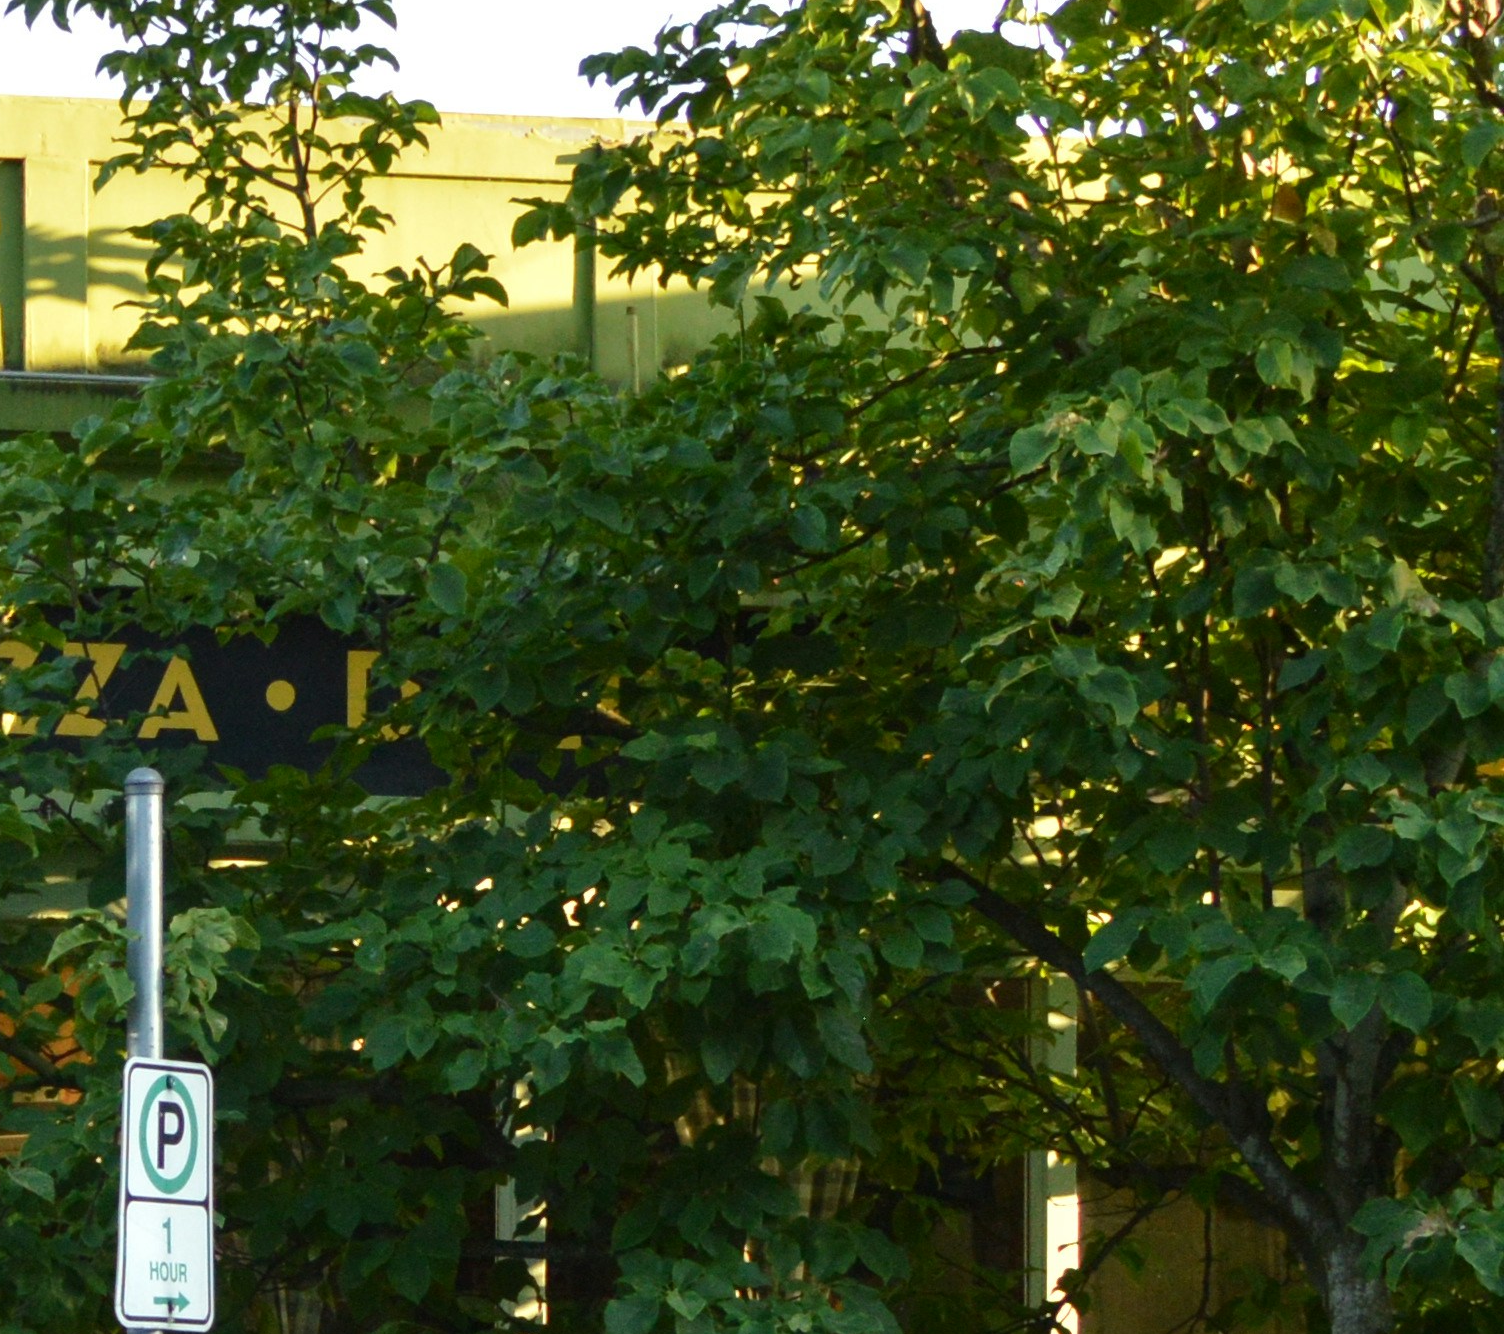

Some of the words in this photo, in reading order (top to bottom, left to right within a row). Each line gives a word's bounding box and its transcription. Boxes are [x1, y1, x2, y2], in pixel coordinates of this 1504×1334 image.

[156, 1101, 185, 1170] P
[161, 1216, 173, 1255] 1
[149, 1260, 188, 1284] HOUR
